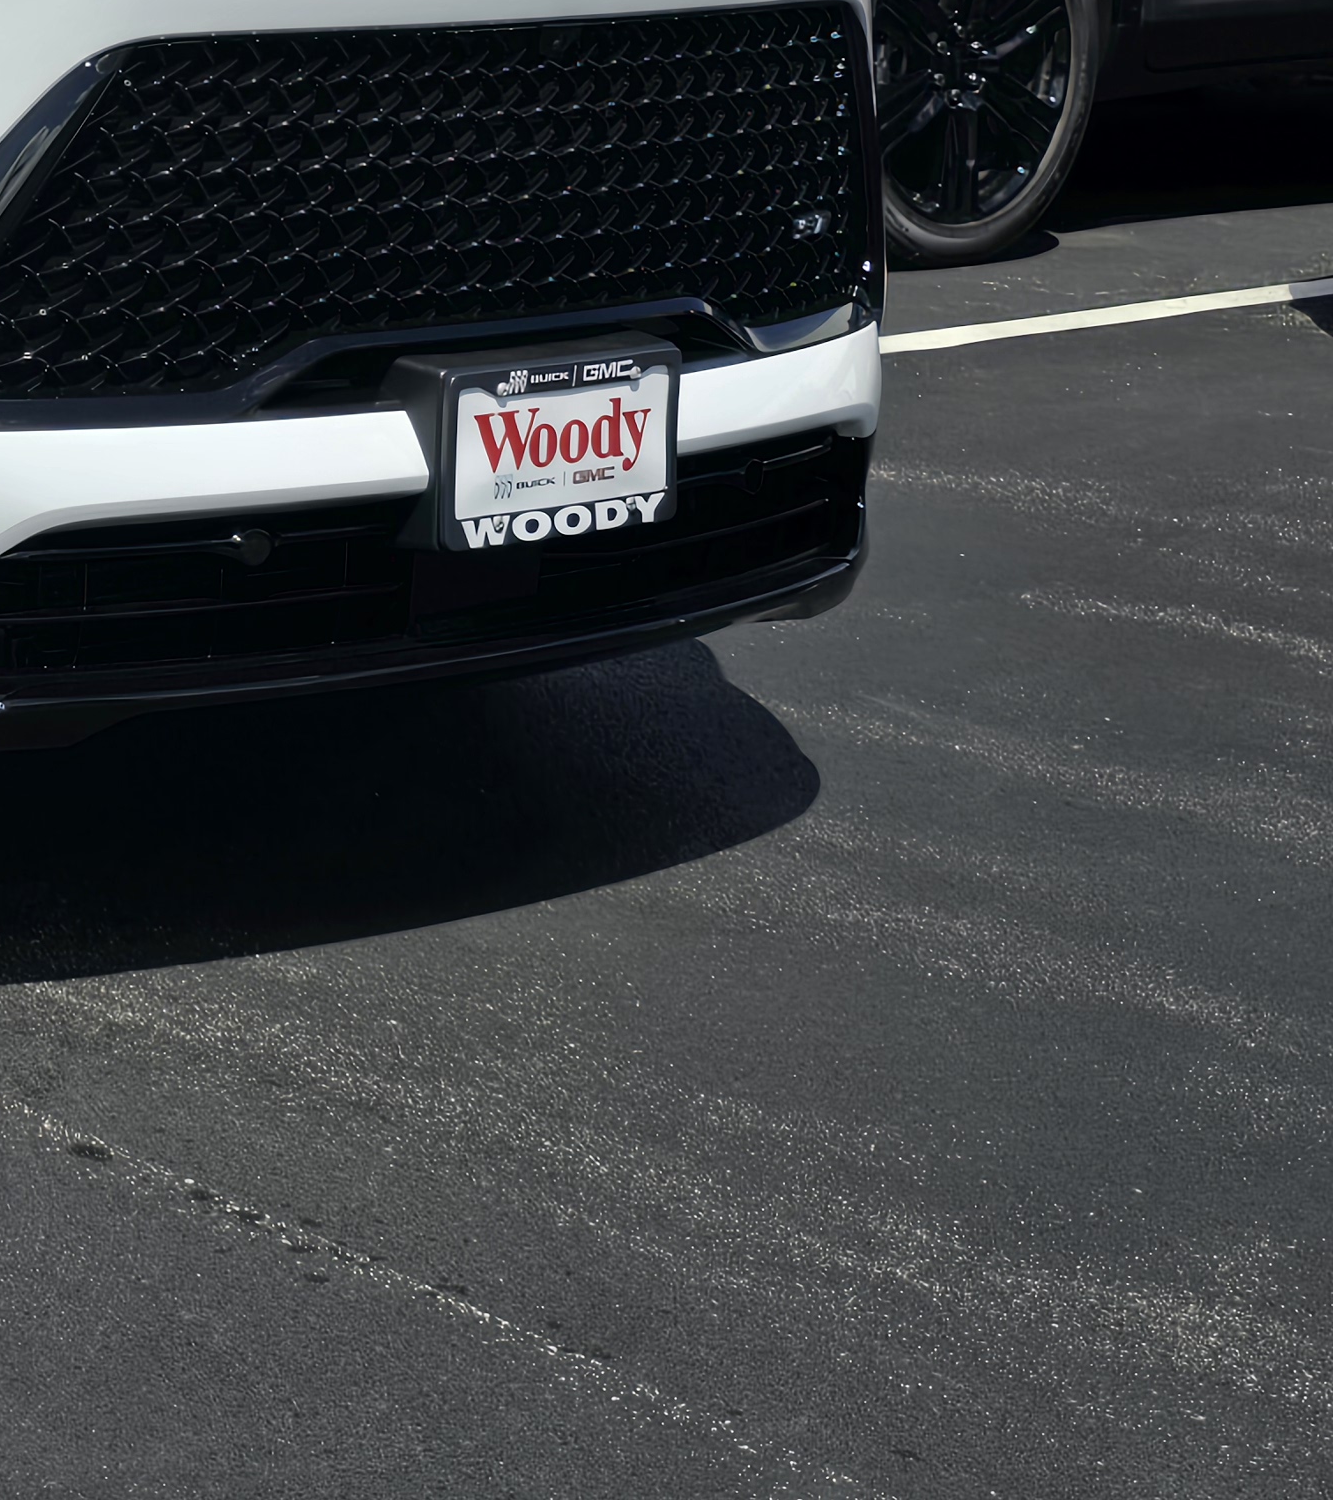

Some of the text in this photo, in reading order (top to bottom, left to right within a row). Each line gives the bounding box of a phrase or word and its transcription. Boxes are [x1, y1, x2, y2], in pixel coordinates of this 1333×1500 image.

[531, 359, 633, 384] BUICK GMC
[474, 397, 651, 473] Woody
[516, 466, 615, 489] BUICK GMC
[461, 492, 665, 548] WOODY
